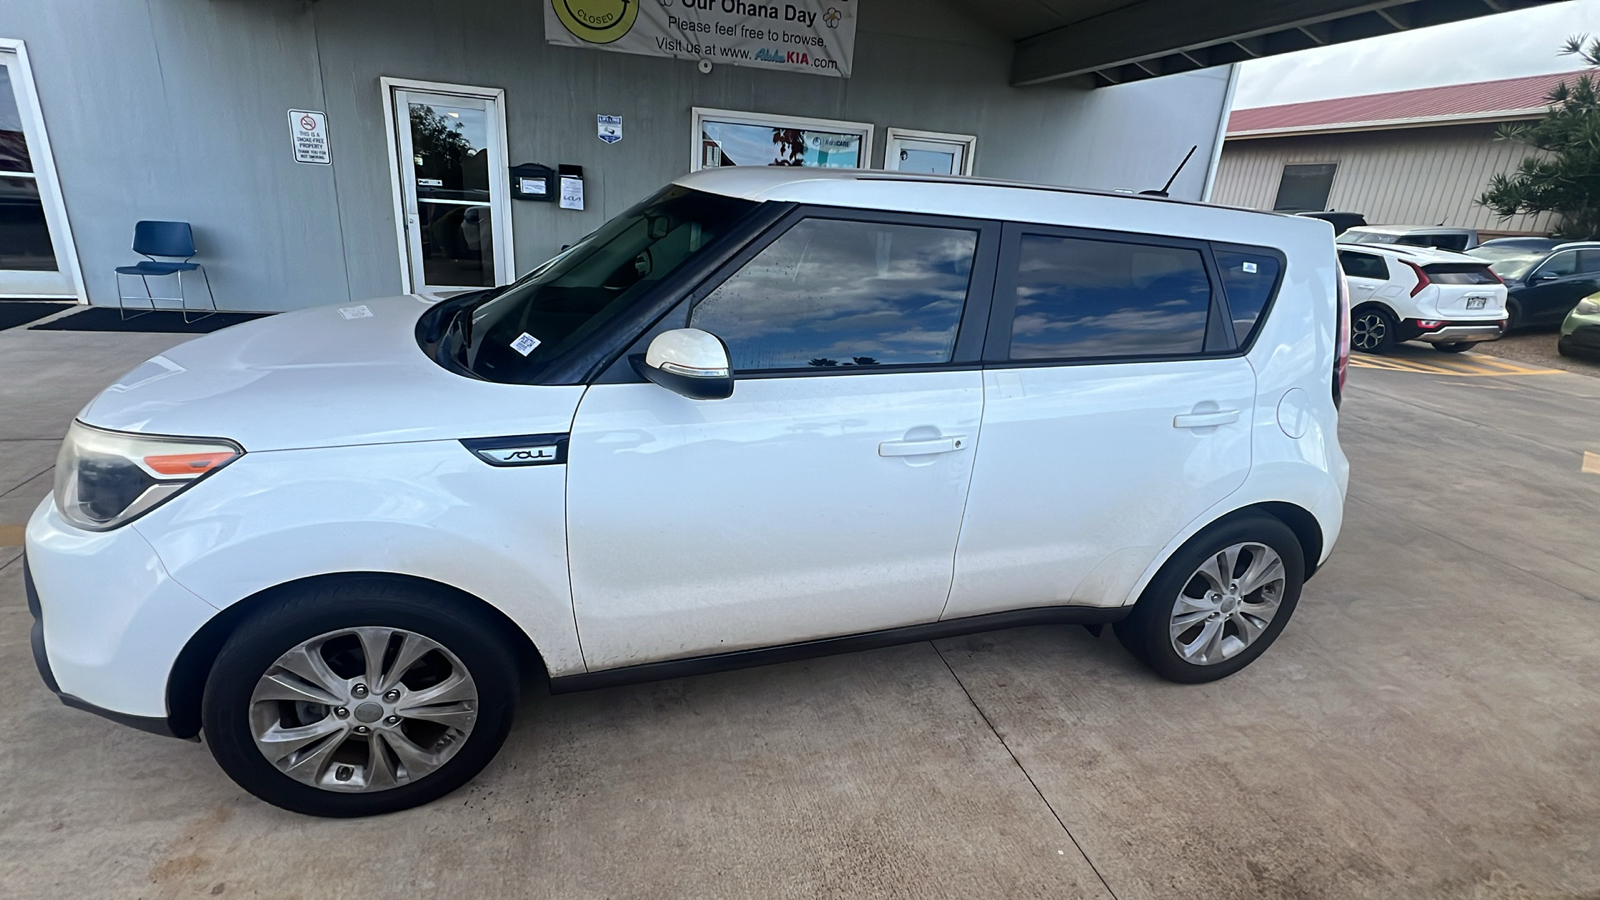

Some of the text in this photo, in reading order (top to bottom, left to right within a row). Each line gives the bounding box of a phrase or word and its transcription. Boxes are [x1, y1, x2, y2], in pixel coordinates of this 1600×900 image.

[577, 8, 614, 24] CLOSED
[721, 0, 778, 19] Ohana
[784, 4, 817, 28] Day
[668, 15, 827, 48] Please feel free to browse.
[655, 36, 682, 52] Visit
[686, 43, 700, 55] us
[704, 44, 716, 56] at
[504, 450, 552, 460] SOUL
